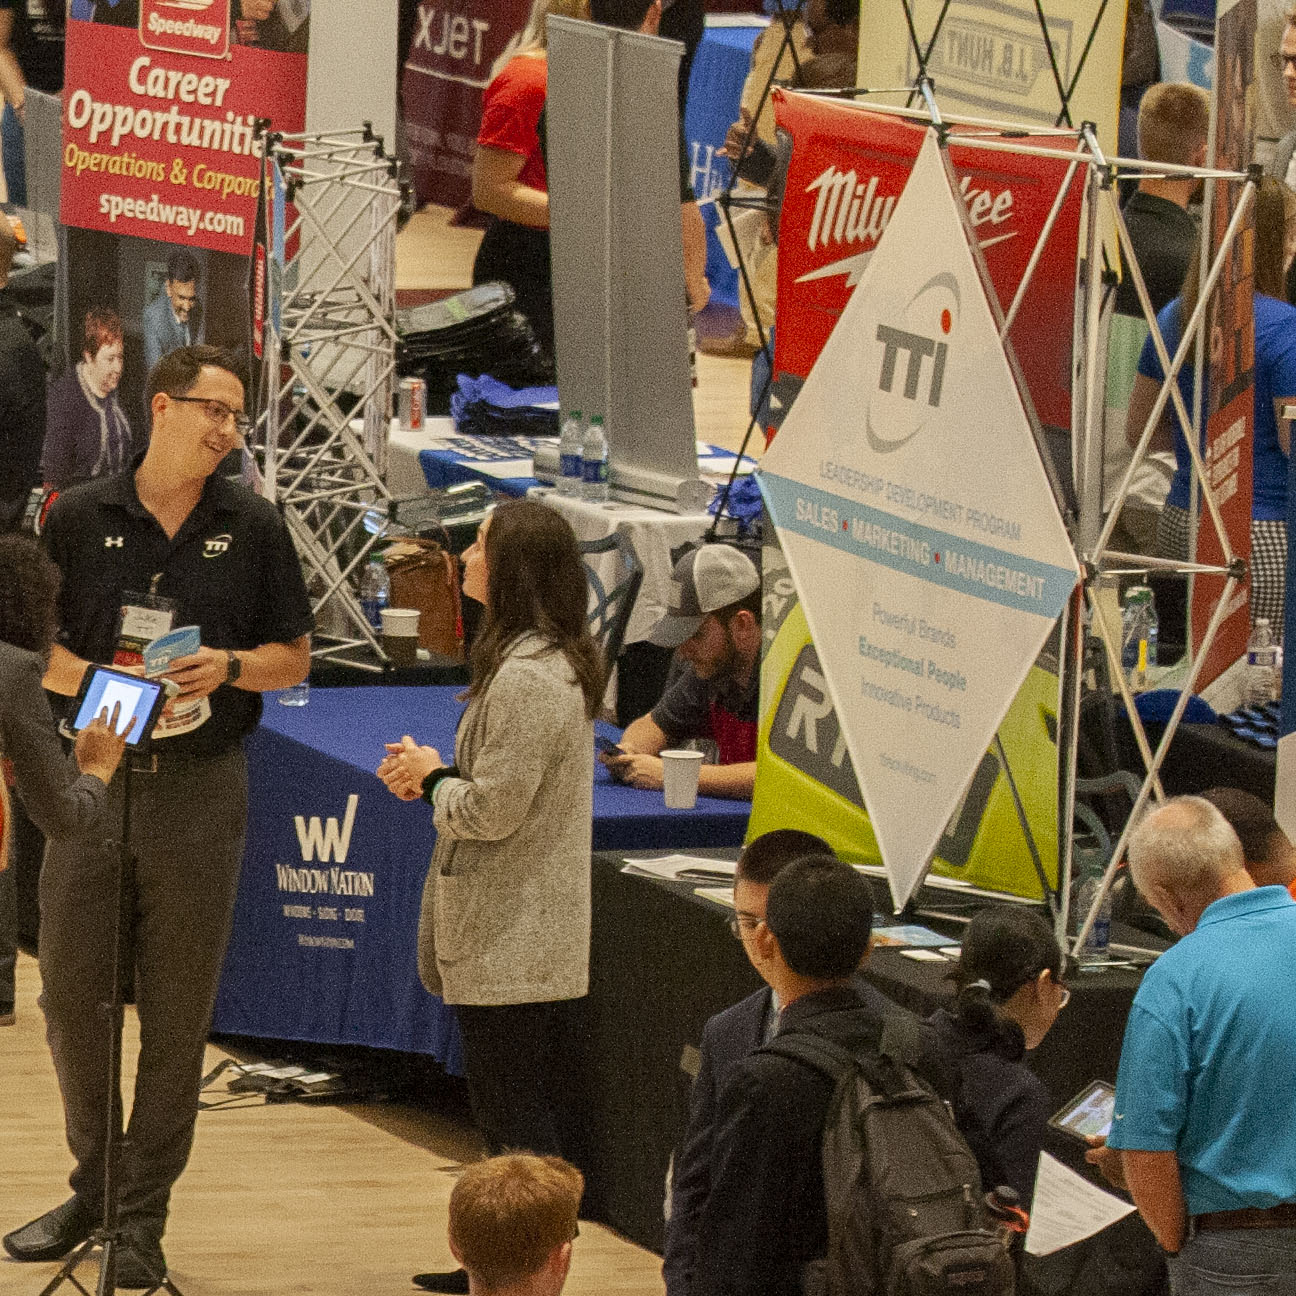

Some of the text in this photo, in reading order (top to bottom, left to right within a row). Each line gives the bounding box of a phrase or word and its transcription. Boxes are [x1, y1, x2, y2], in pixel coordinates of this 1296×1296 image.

[147, 12, 222, 44] Speedway
[129, 56, 230, 107] Career
[68, 89, 263, 158] Opportuniti
[65, 143, 165, 184] Operations
[169, 158, 187, 186] &
[99, 194, 244, 237] speedway.com
[820, 461, 1022, 541] LEADERSHIP DEVELOPMENT PROGRAM
[795, 497, 1046, 600] SALES MARKETING MANAGEMENT
[858, 635, 967, 692] Exceptional People
